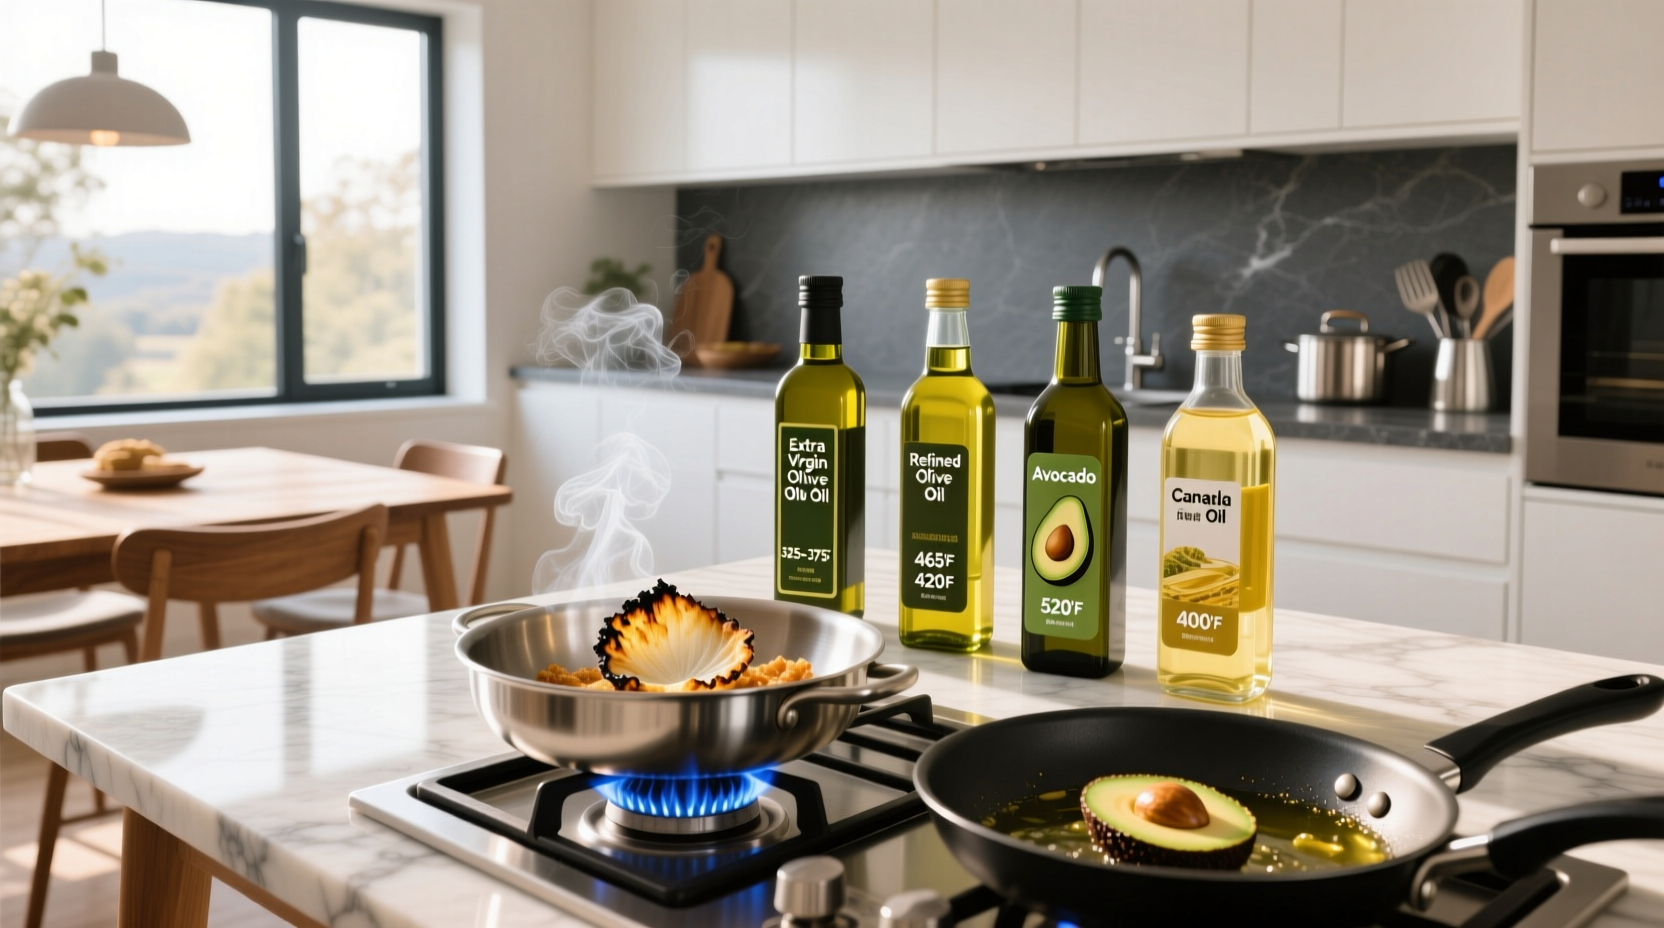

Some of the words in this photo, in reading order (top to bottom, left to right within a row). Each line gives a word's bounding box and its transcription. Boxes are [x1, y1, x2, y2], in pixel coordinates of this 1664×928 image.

[789, 437, 826, 453] Extra
[909, 452, 961, 468] Refined
[1032, 465, 1097, 484] Avocado
[810, 487, 829, 503] Oil
[924, 486, 945, 502] Oil
[1205, 508, 1226, 524] Oil
